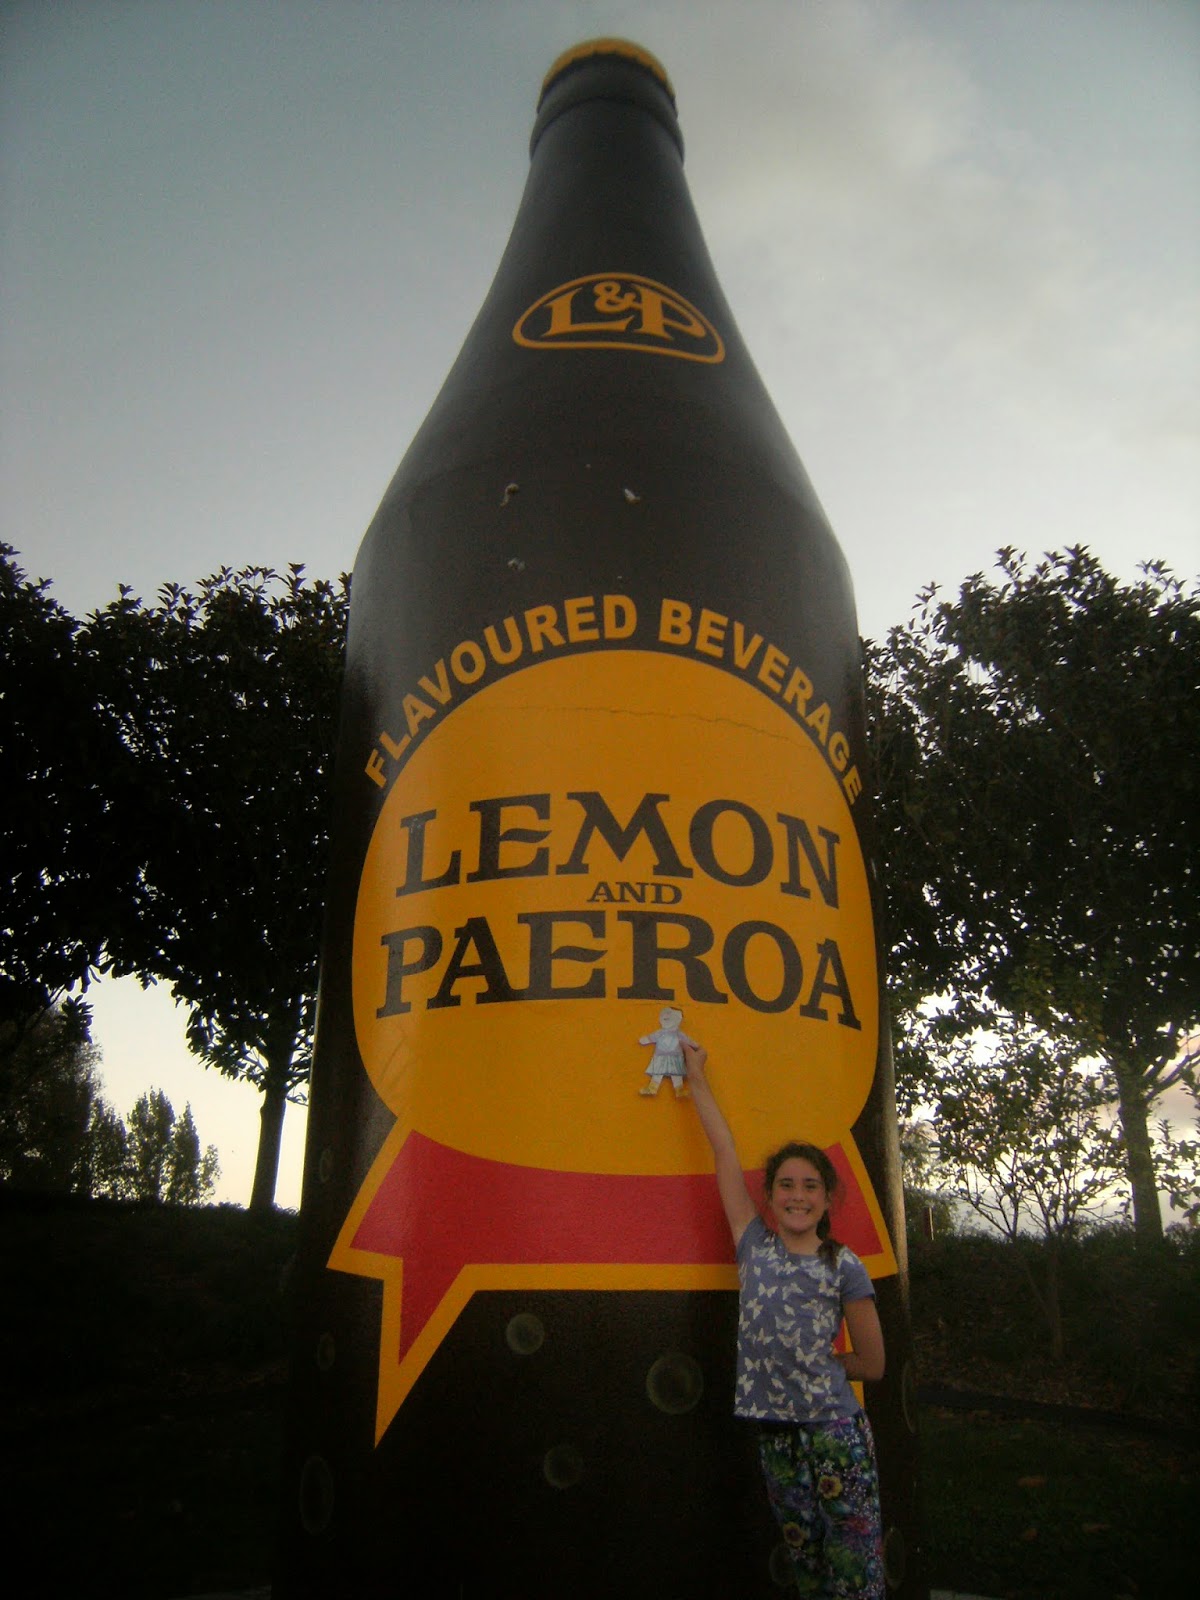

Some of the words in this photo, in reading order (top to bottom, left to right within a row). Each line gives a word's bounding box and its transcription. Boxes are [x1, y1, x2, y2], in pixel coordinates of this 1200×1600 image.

[365, 594, 637, 788] FLAVOURED
[659, 598, 863, 805] BEVERAGE
[396, 791, 840, 909] LEMON
[587, 881, 682, 904] AND
[376, 910, 862, 1031] PAEROA
